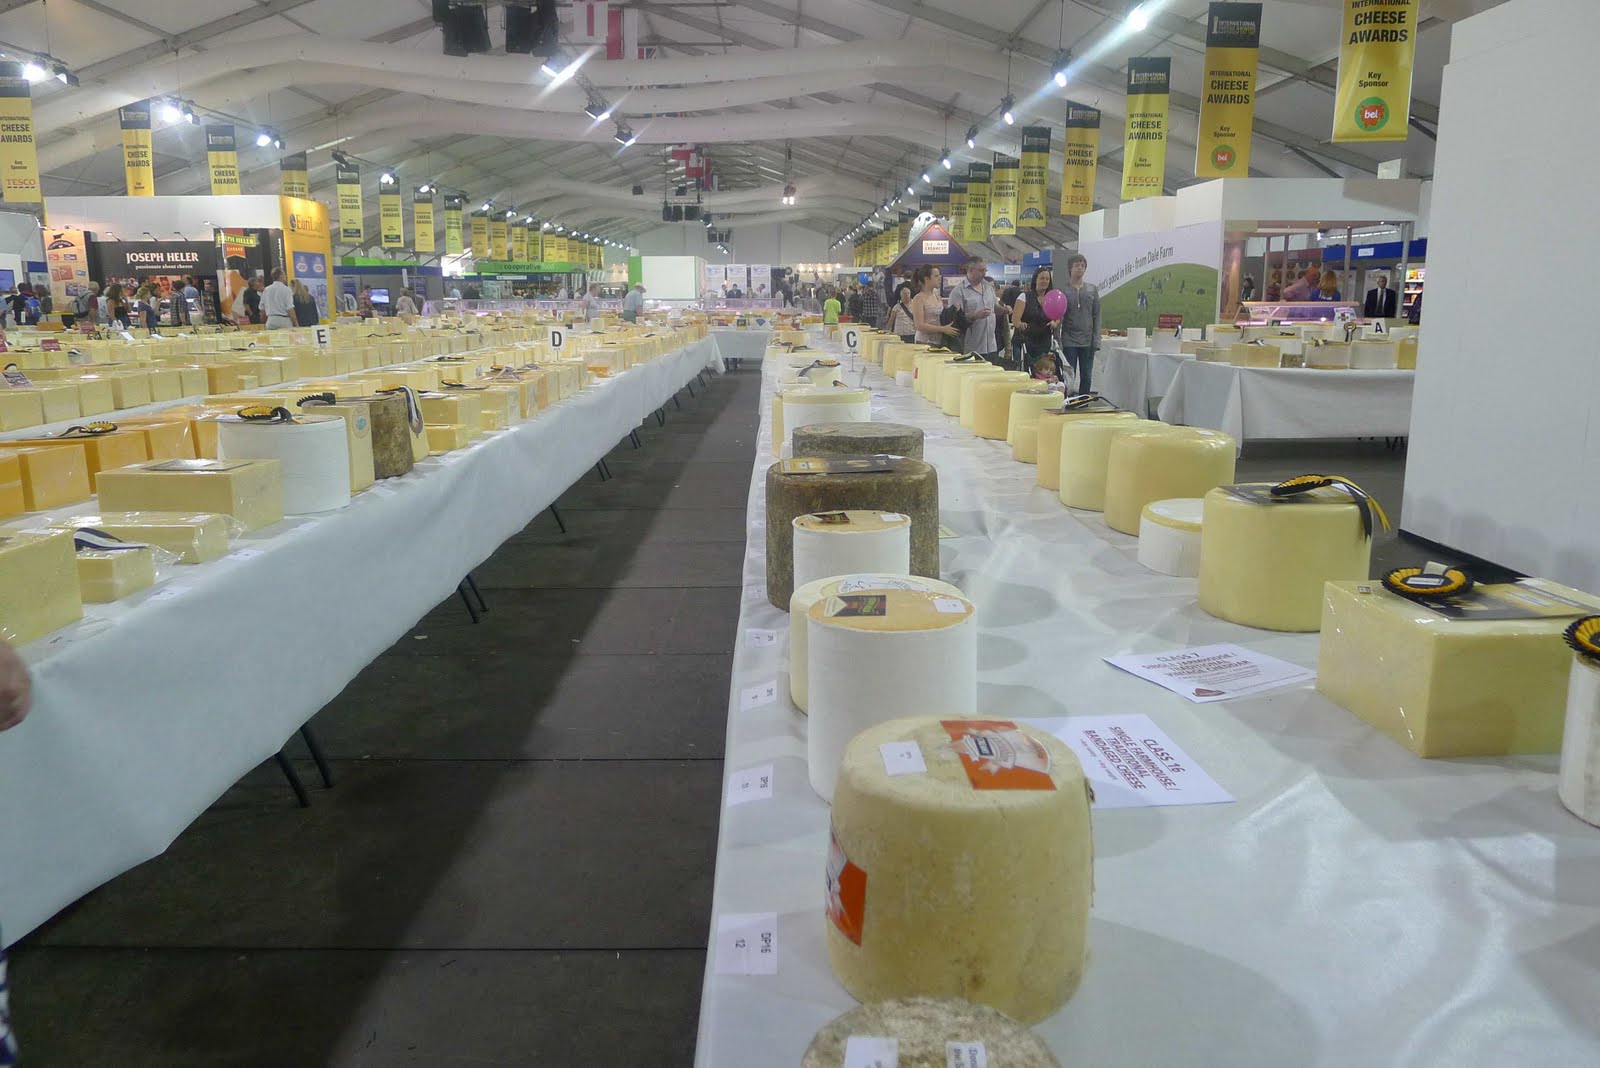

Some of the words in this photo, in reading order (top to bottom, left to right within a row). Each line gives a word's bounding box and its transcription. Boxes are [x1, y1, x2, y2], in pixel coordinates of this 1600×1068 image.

[1354, 11, 1407, 26] CHEESE
[1348, 29, 1408, 45] AWARDS
[1368, 72, 1382, 80] Key
[1211, 80, 1249, 90] CHEESE
[1359, 80, 1389, 88] Sponsor
[1207, 94, 1250, 104] AWARDS
[1364, 109, 1379, 119] bel
[1, 124, 30, 132] CHEESE
[1131, 120, 1162, 129] CHEESE
[1, 135, 33, 143] AWARDS
[1128, 132, 1163, 140] AWARDS
[1068, 150, 1093, 158] CHEESE
[1066, 158, 1094, 167] AWARDS
[126, 252, 163, 264] JOSEPH
[166, 252, 199, 263] HELER
[1147, 248, 1160, 265] Dale
[1160, 245, 1174, 259] Farm
[1375, 322, 1383, 333] A
[316, 329, 327, 344] E
[551, 331, 563, 347] D
[846, 330, 858, 348] C
[1156, 653, 1192, 661] CLASS
[1085, 730, 1122, 763] BANDAGED
[1117, 764, 1147, 790] CHEESE
[1107, 738, 1151, 778] TRADITIONAL
[1110, 726, 1137, 746] SINGLE
[1131, 747, 1176, 787] FARMHOUSE
[1143, 739, 1174, 762] CLASS
[1168, 763, 1186, 773] 16
[735, 938, 746, 949] 12
[760, 932, 772, 954] DP16
